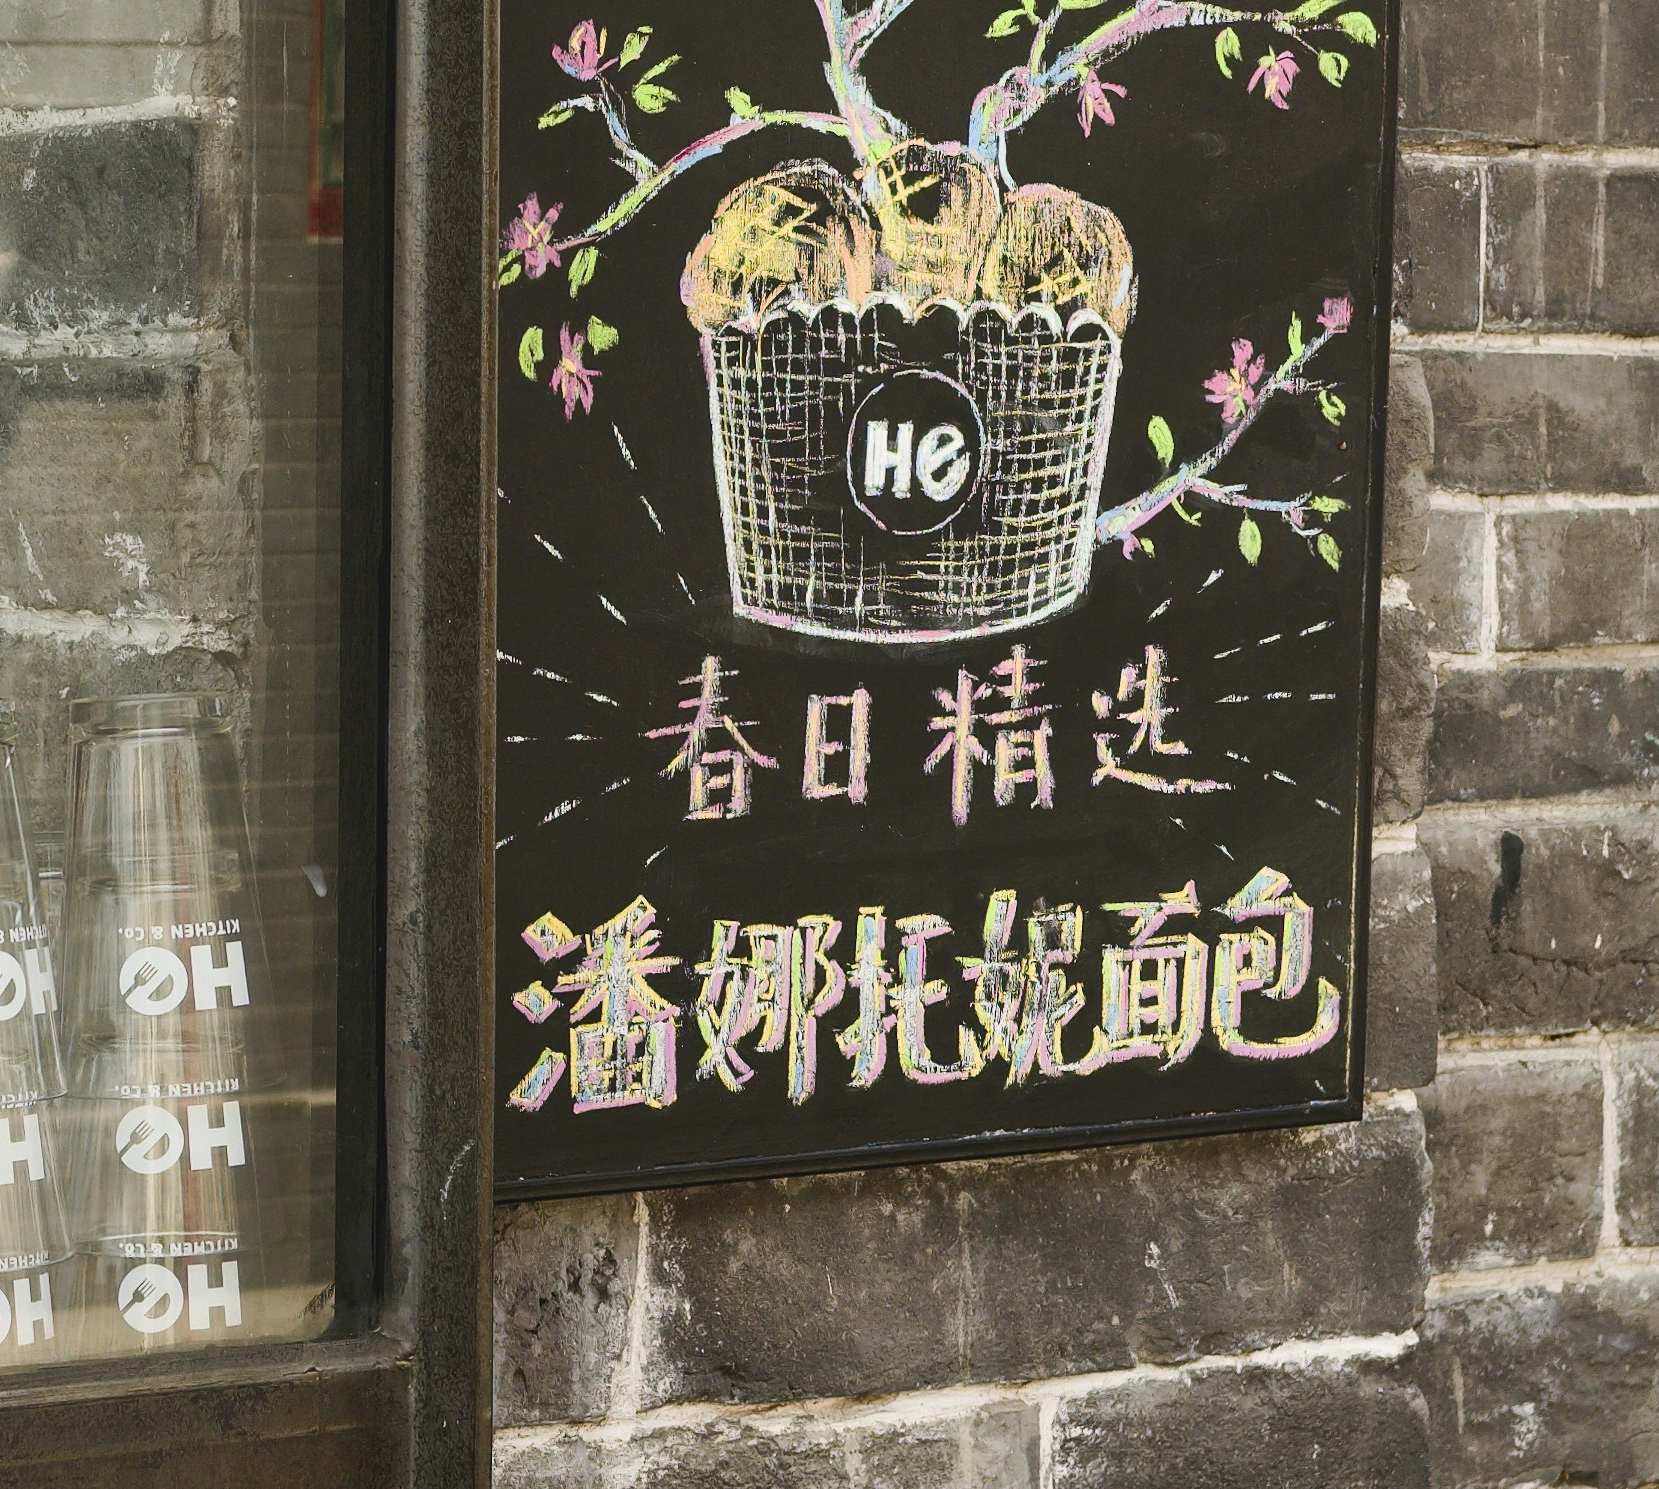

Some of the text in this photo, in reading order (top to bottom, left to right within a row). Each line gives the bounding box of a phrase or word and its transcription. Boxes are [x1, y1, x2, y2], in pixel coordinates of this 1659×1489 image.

[643, 643, 1236, 826] 春日精选
[170, 918, 240, 939] KITCHEN
[507, 866, 1341, 1114] 潘娜托妮面包
